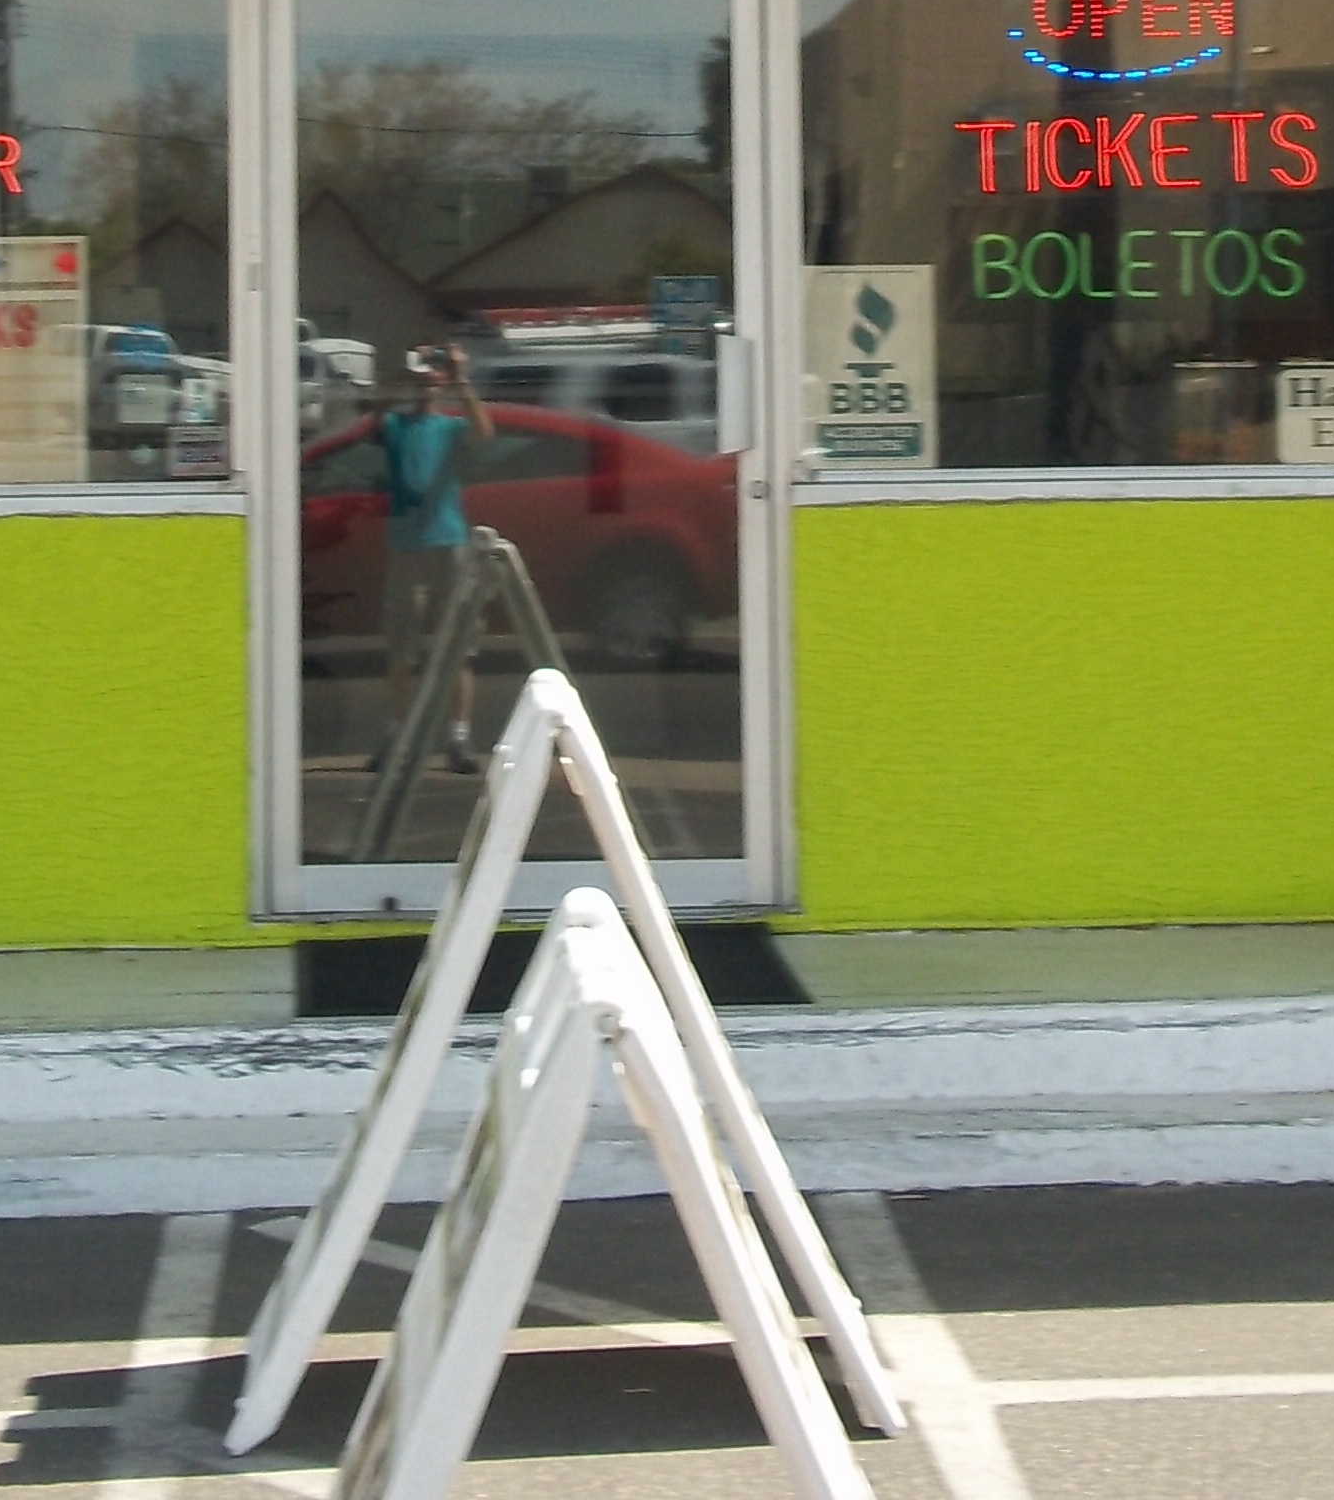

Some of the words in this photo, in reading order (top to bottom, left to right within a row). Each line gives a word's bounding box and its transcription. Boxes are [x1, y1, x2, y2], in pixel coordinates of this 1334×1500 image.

[953, 111, 1319, 194] TICKETS
[971, 228, 1307, 301] BOLETOS
[827, 382, 910, 415] BBB
